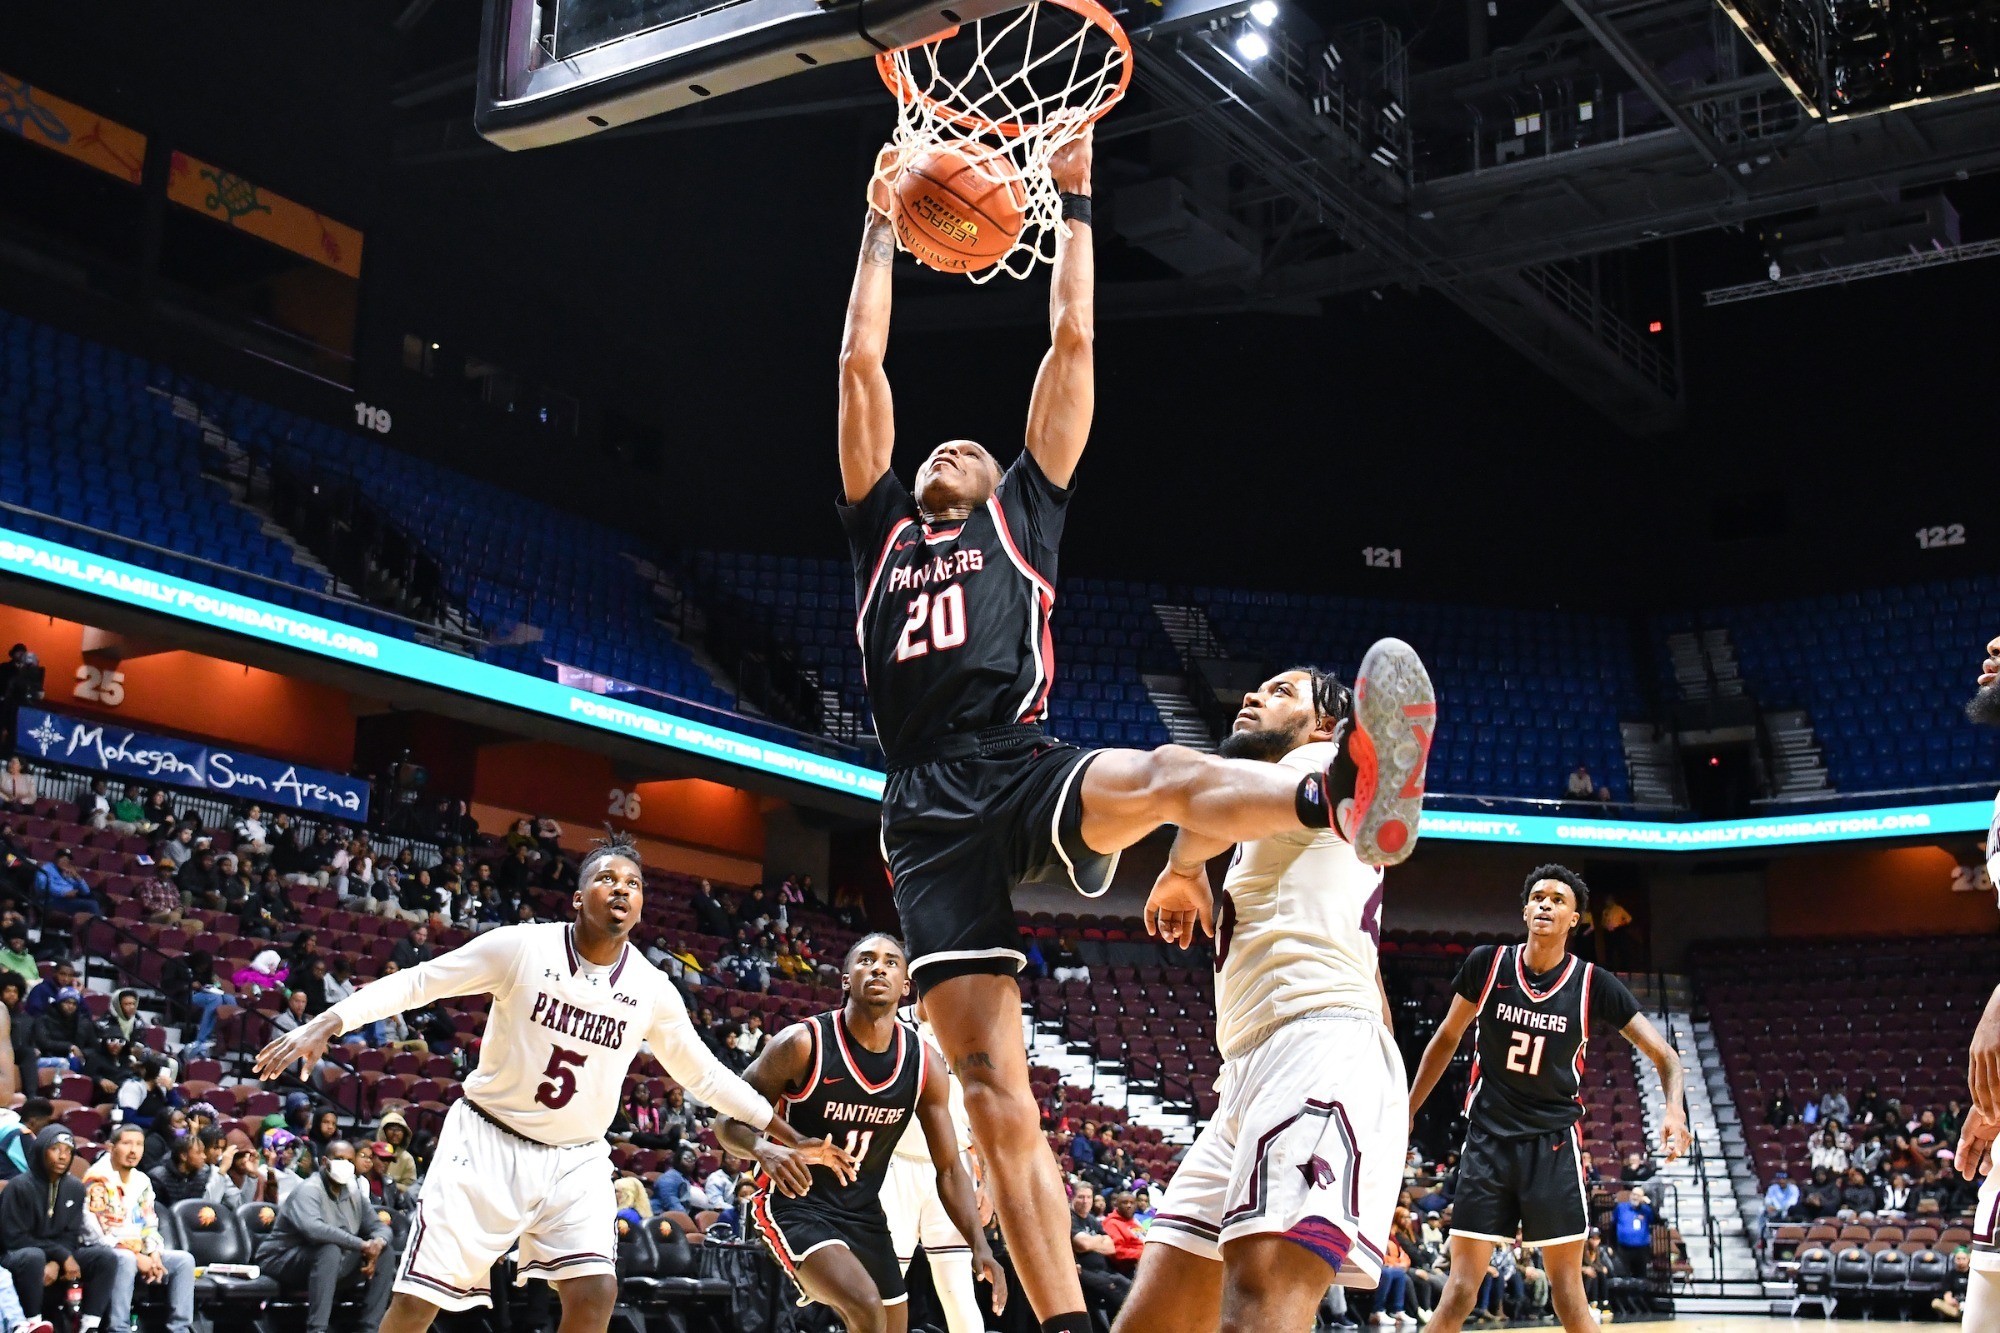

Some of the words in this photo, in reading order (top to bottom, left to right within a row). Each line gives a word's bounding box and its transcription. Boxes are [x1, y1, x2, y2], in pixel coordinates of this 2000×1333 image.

[912, 200, 978, 247] LEGACY
[355, 402, 392, 434] 119
[1361, 546, 1402, 569] 121
[1915, 524, 1966, 550] 122
[896, 583, 968, 663] 20
[73, 665, 125, 706] 25
[570, 697, 673, 737] POSITIVELY
[674, 725, 762, 761] IMPACTING
[763, 749, 856, 786] INDIVIDUALS
[67, 724, 203, 781] Mohegan
[208, 753, 267, 789] Sun
[272, 765, 361, 811] Arena
[608, 788, 642, 821] 26
[1418, 817, 1522, 837] MMUNITY.
[530, 991, 627, 1050] PANTHERS
[613, 992, 638, 1008] CAA
[1496, 1003, 1568, 1034] PANTHERS
[1506, 1030, 1546, 1076] 21
[534, 1042, 588, 1110] 5
[823, 1101, 906, 1125] PANTHERS
[844, 1130, 874, 1171] 11
